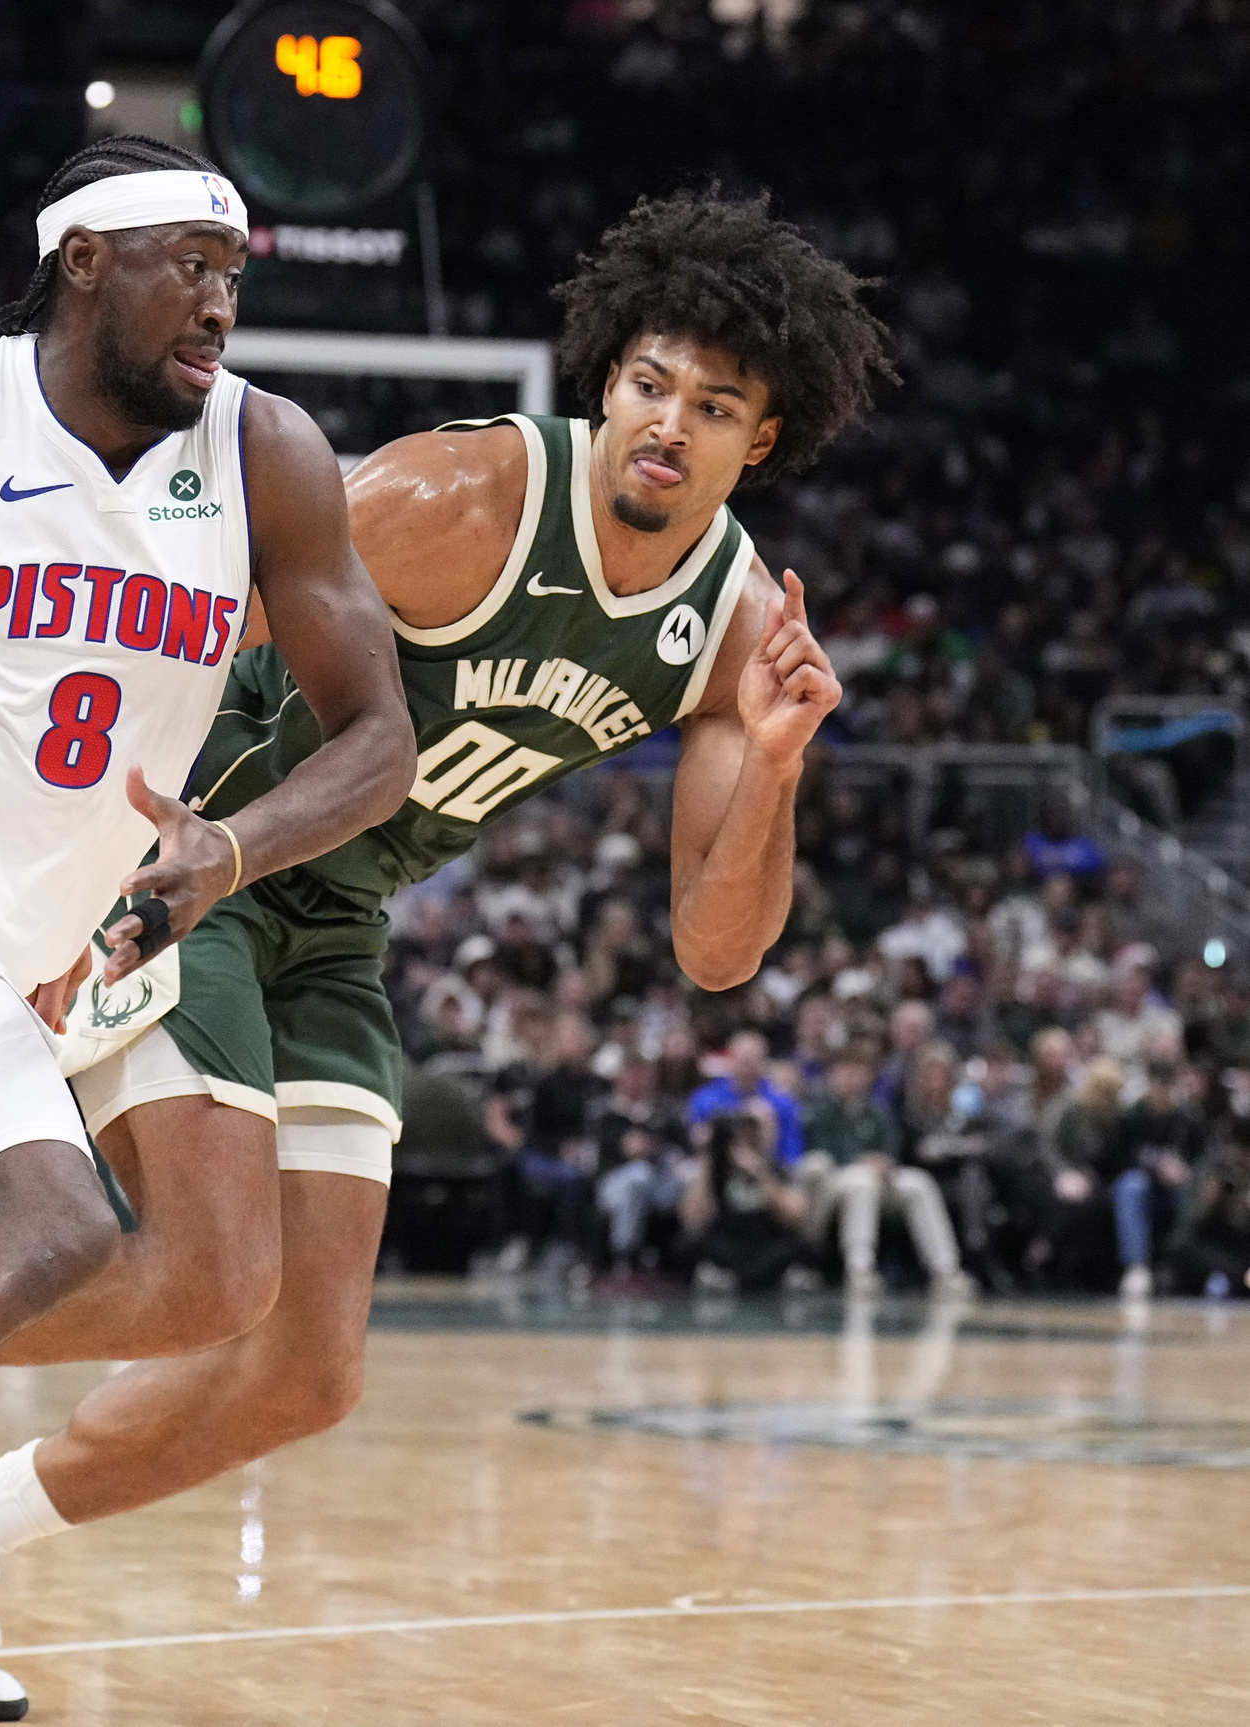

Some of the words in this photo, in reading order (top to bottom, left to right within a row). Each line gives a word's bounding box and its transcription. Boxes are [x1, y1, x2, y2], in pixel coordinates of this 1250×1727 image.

[148, 501, 223, 522] StockX
[35, 671, 122, 790] 8
[407, 719, 564, 824] 00
